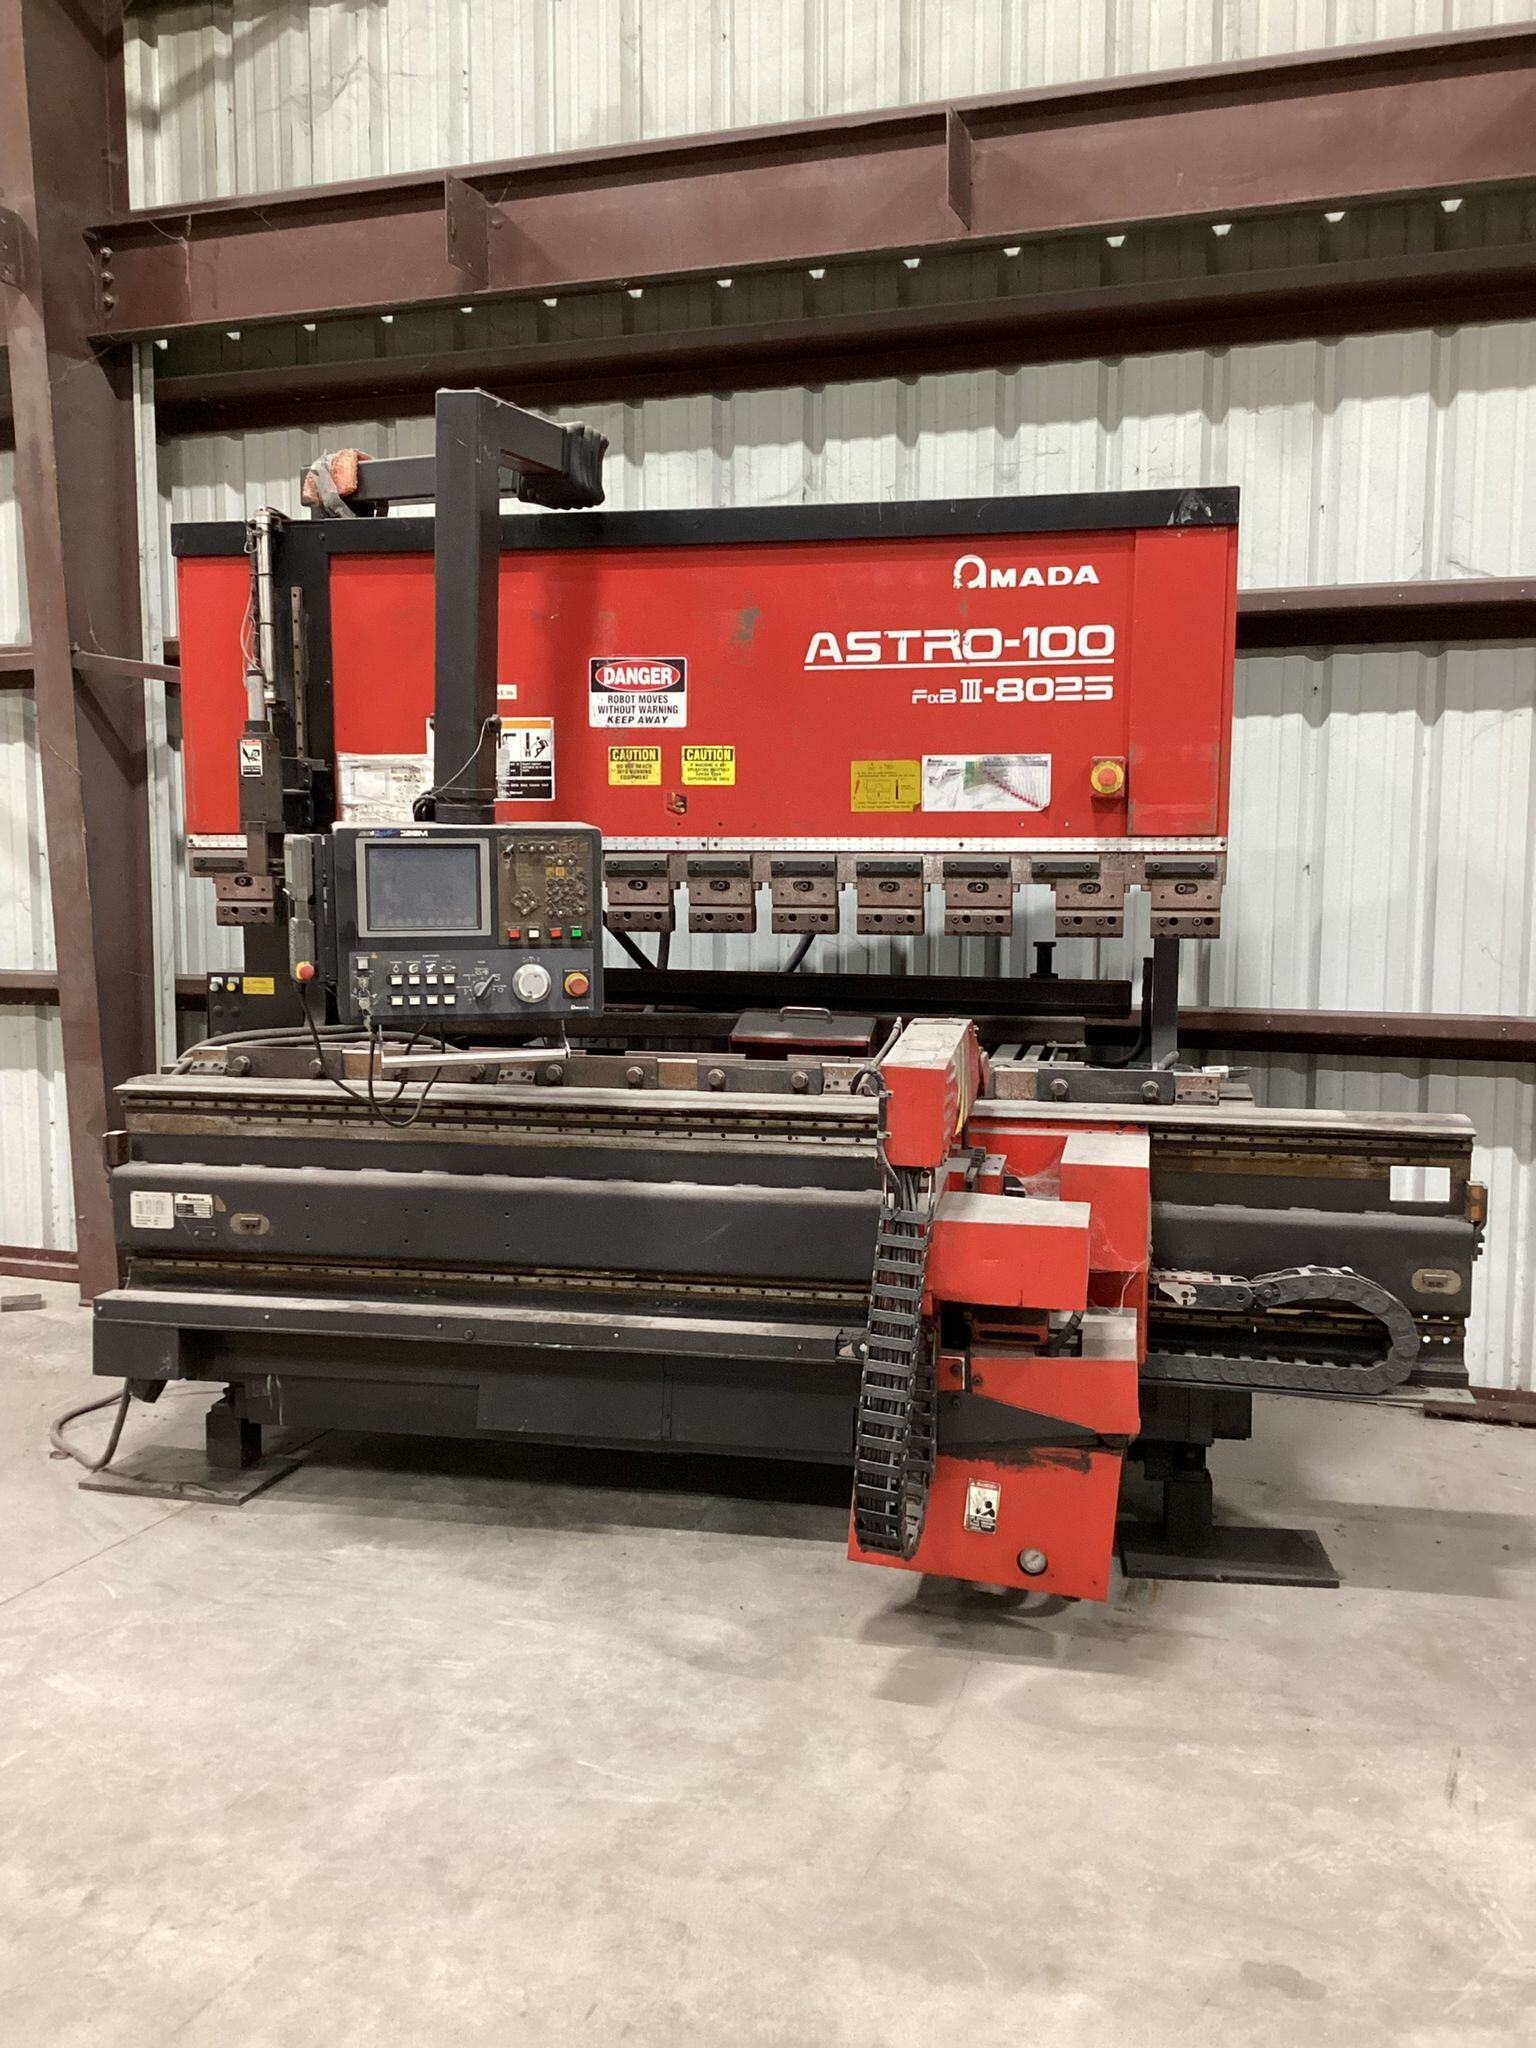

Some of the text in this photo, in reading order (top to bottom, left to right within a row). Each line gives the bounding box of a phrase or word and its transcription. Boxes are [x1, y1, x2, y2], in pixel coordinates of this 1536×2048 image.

[953, 554, 1100, 589] AMADA
[804, 624, 1115, 664] ASTRO-100
[603, 666, 673, 686] DANGER
[607, 694, 669, 704] ROBOT MOVES
[598, 705, 679, 715] WITHOUT WARNING
[607, 715, 669, 724] KEEP AWAY
[612, 749, 657, 761] CAUTION
[686, 748, 731, 761] CAUTION
